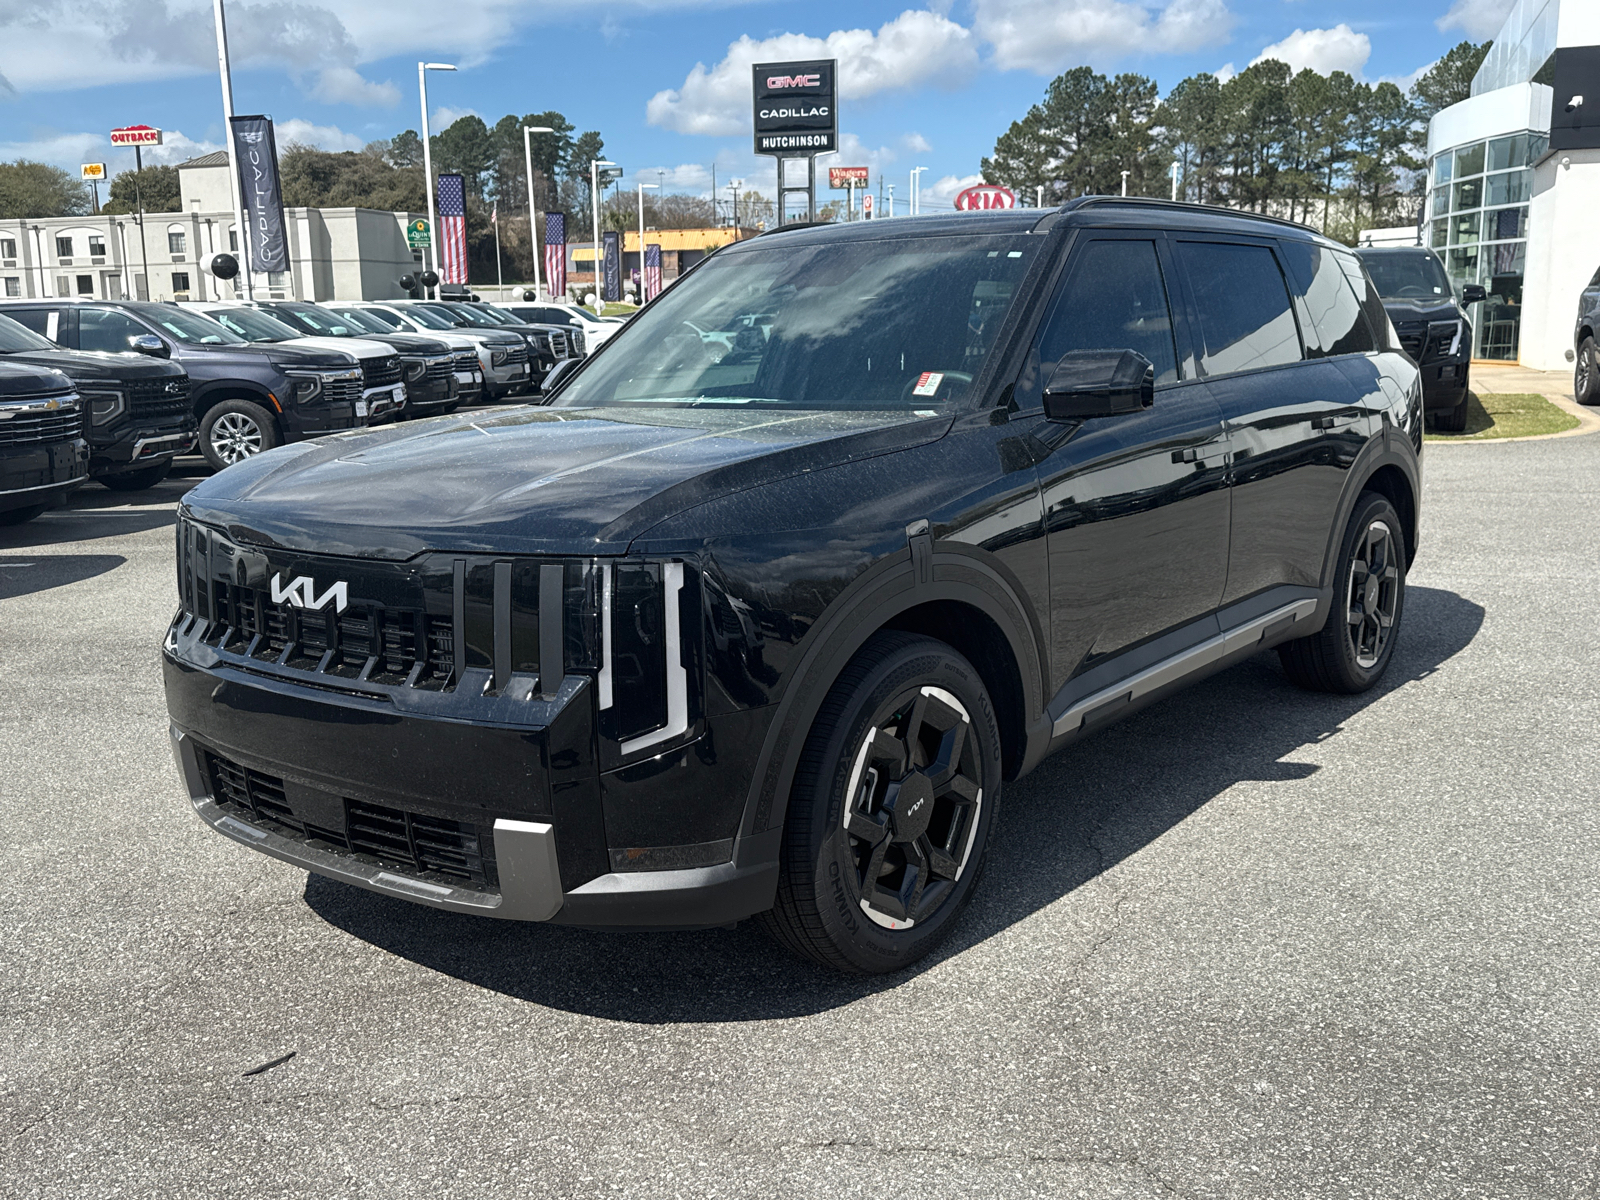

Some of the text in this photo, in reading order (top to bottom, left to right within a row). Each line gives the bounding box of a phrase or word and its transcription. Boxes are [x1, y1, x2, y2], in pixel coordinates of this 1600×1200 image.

[767, 74, 820, 89] GMC
[760, 107, 828, 118] CADILLAC
[111, 132, 157, 142] OUTBACK
[762, 135, 828, 148] HUTCHINSON
[967, 192, 1005, 210] KIA
[270, 572, 348, 614] KIA
[944, 663, 968, 681] OUTSIDE
[977, 692, 1000, 762] KUMHO
[829, 860, 860, 936] KUMHO
